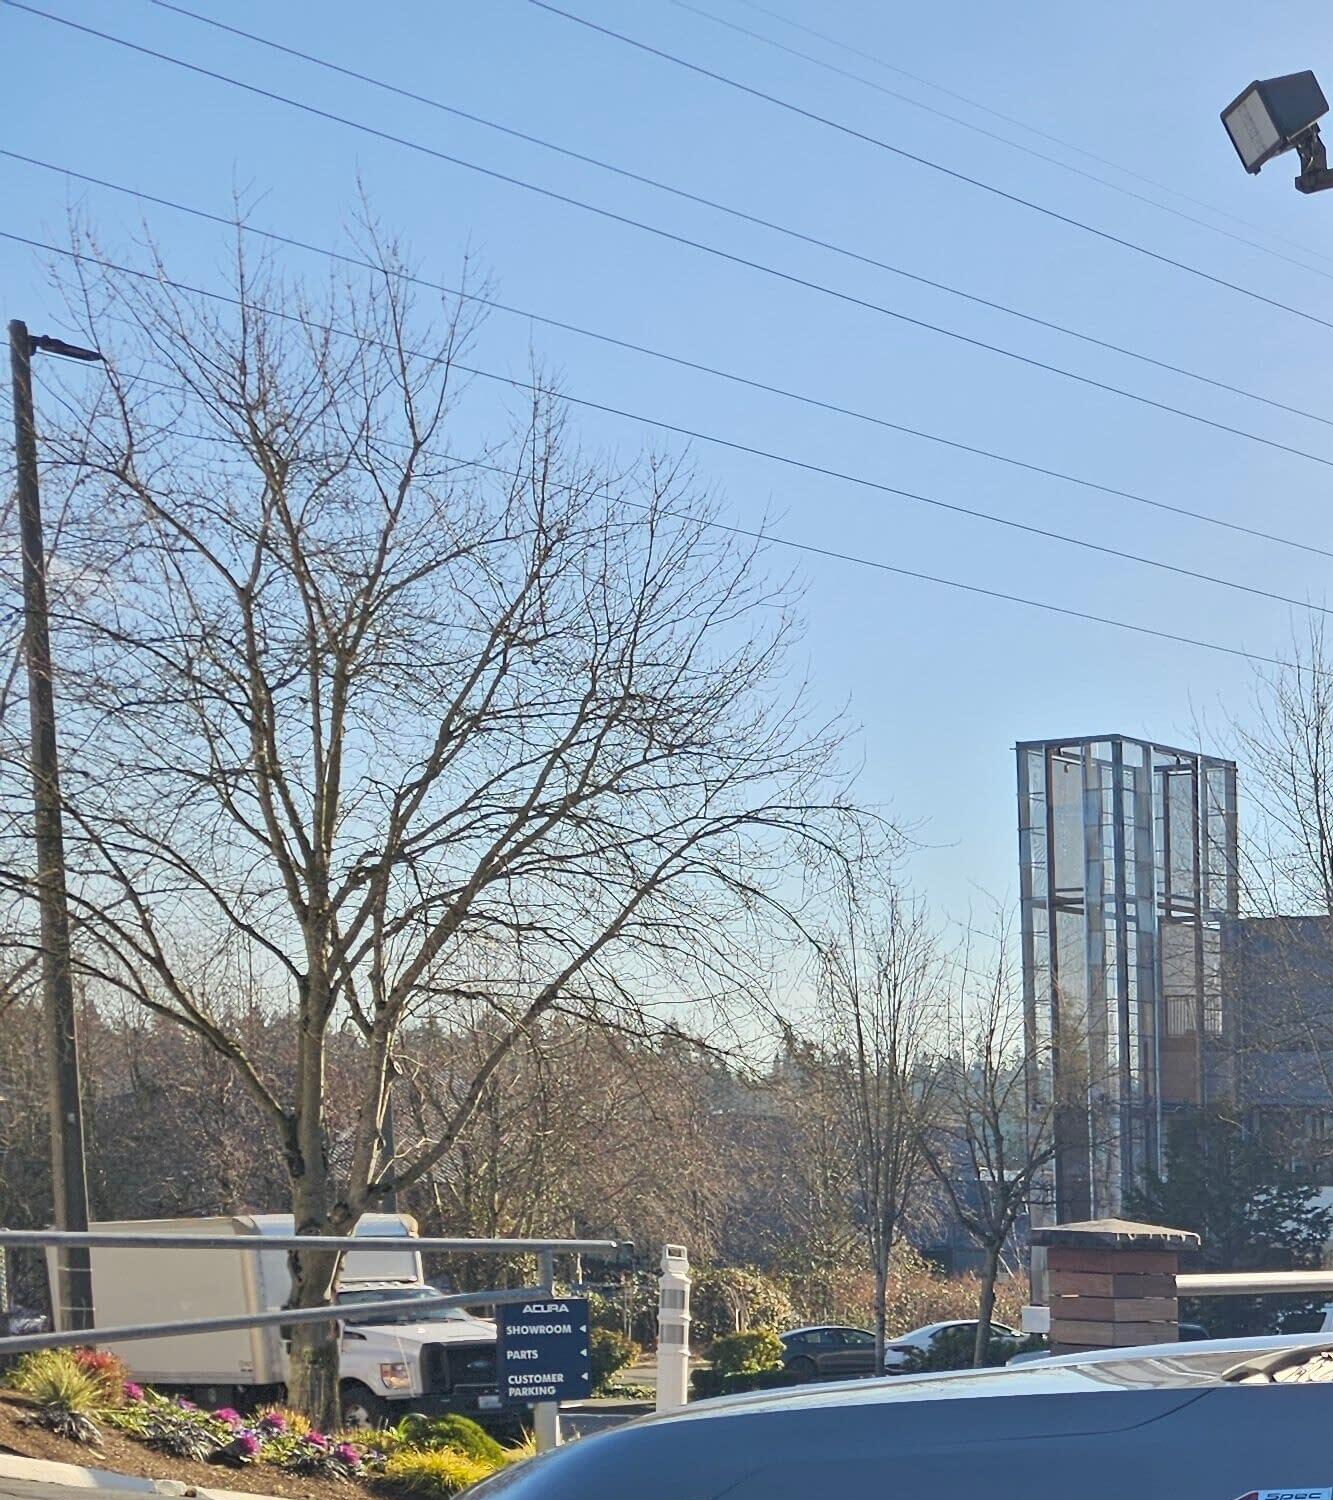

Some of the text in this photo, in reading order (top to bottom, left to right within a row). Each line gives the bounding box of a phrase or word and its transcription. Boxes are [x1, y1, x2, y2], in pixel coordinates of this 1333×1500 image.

[522, 1303, 569, 1313] ACURA
[506, 1324, 572, 1336] SHOWROOM
[506, 1349, 539, 1360] PARTS
[508, 1373, 564, 1385] CUSTOMER
[508, 1385, 556, 1397] PARKING
